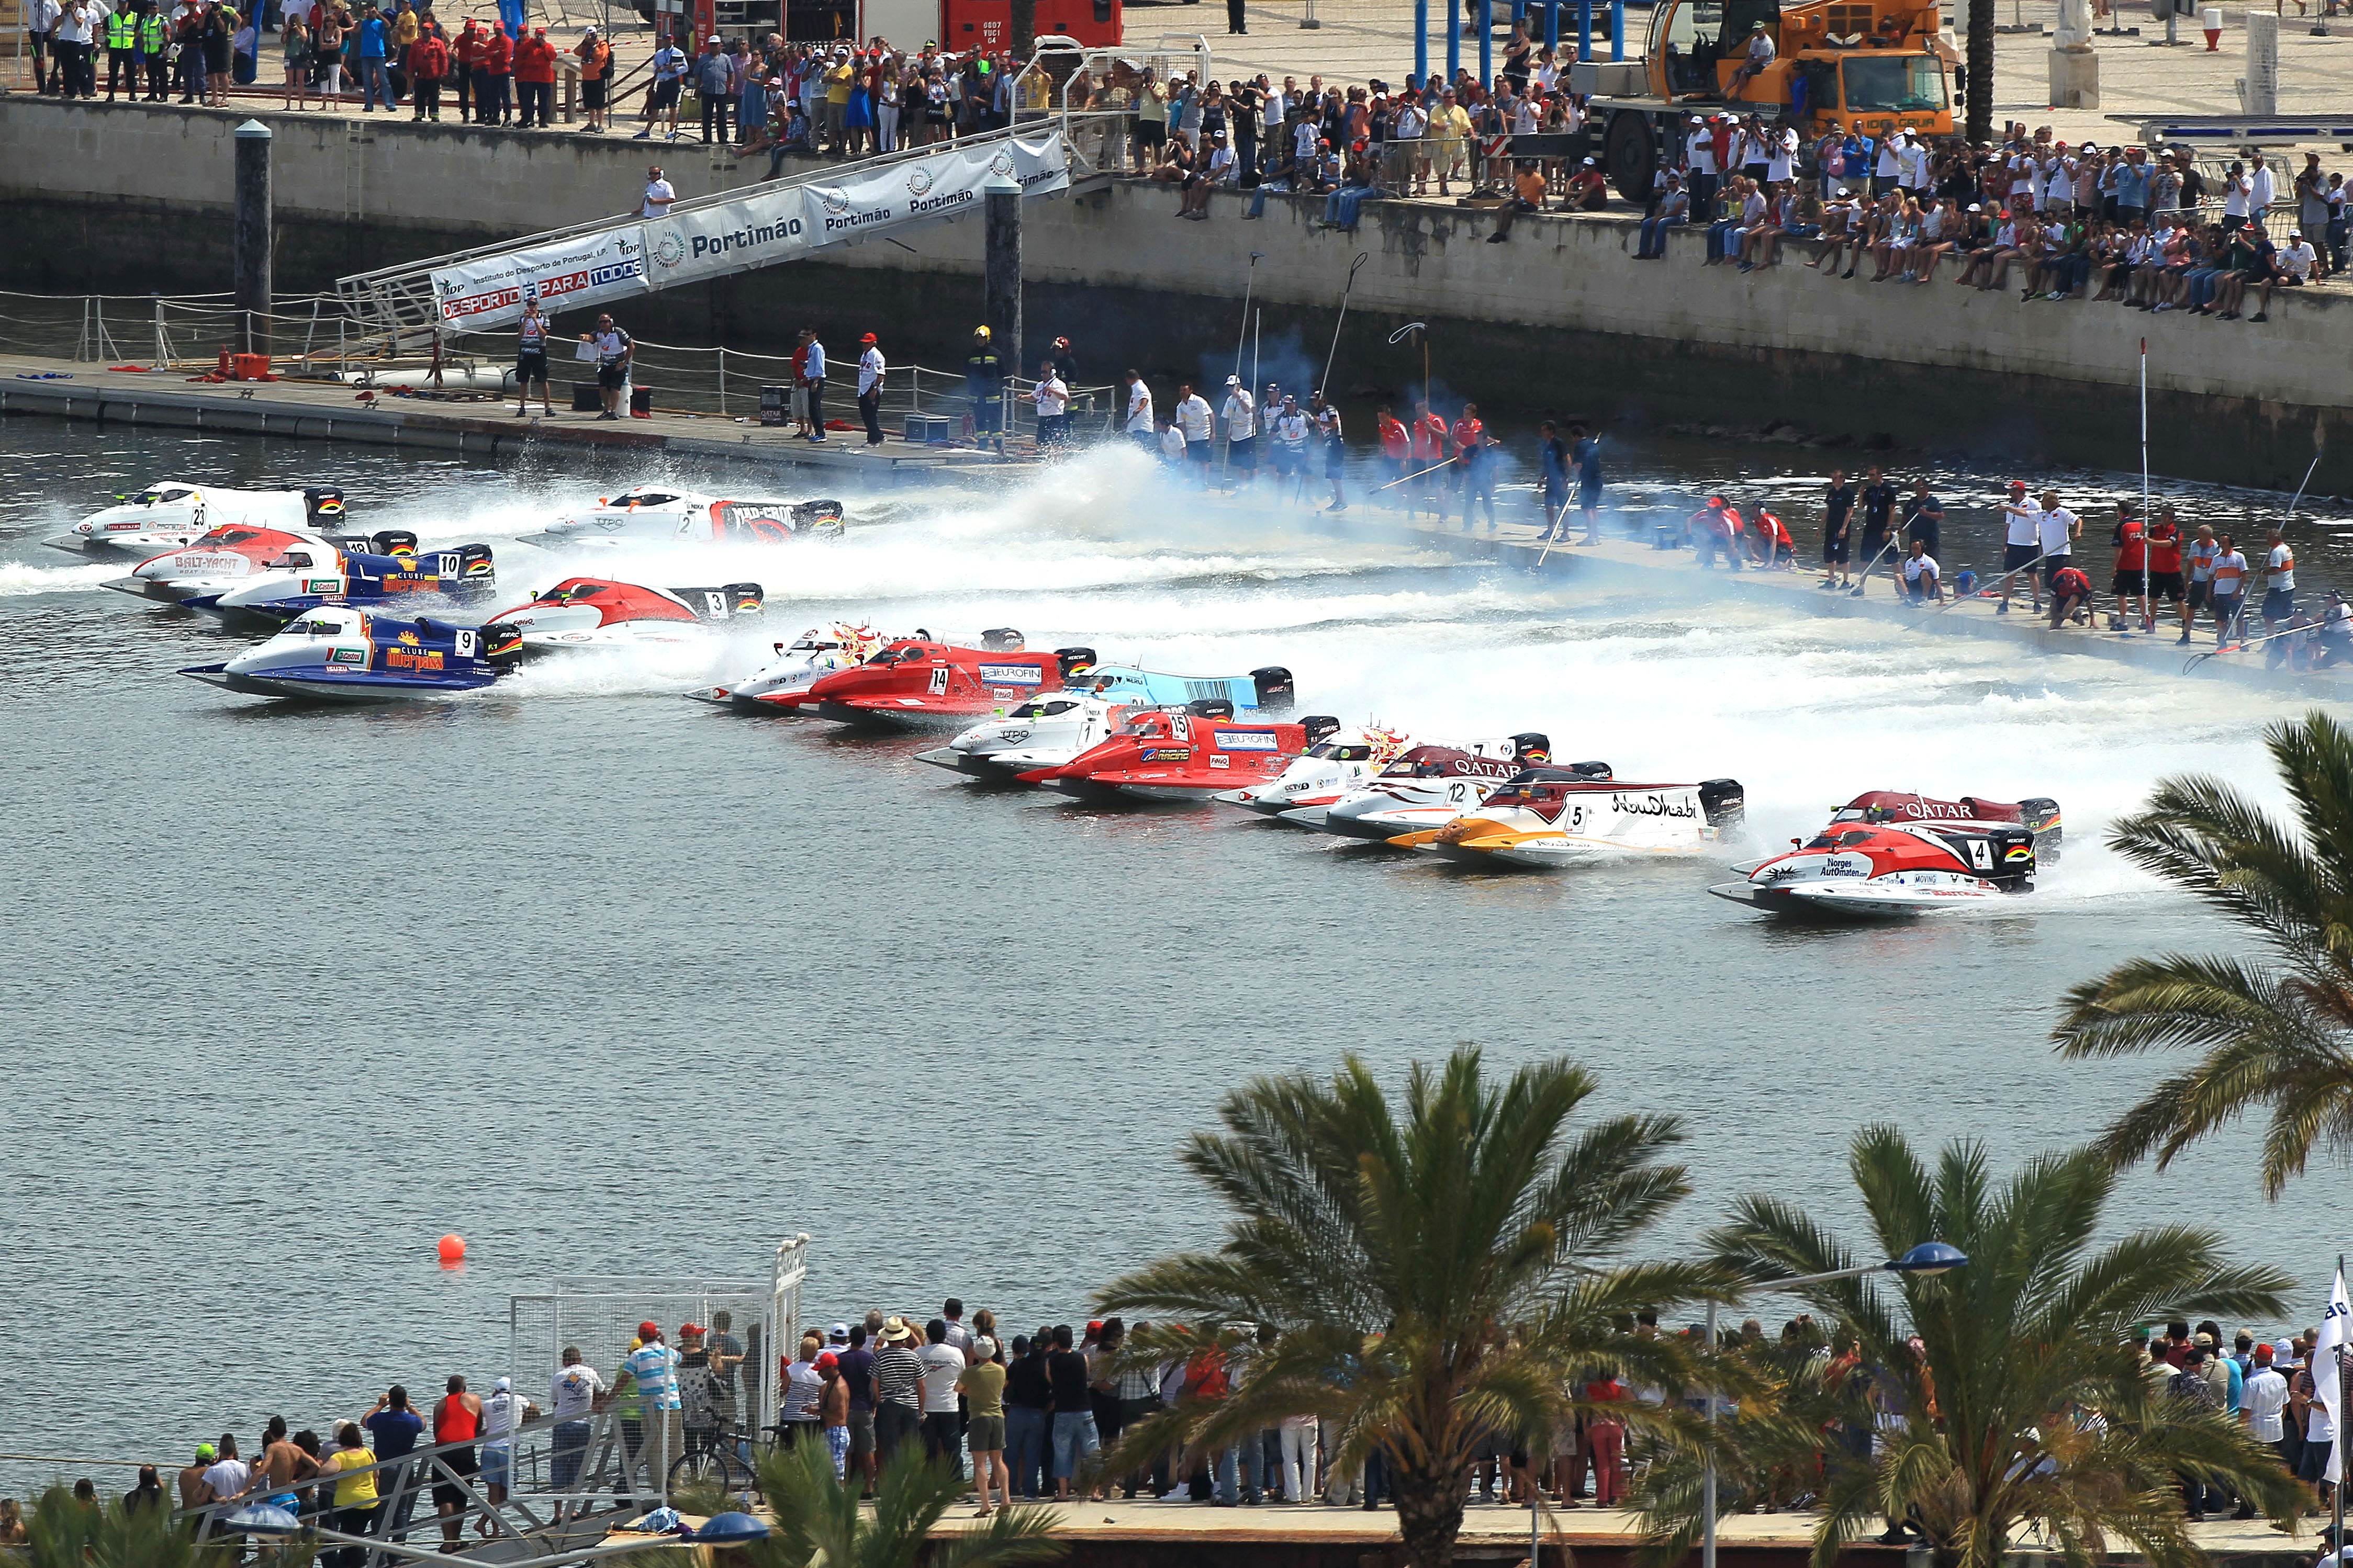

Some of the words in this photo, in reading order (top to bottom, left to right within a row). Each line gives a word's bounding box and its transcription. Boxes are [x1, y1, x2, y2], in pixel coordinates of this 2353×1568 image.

[1016, 170, 1054, 187] timão
[910, 189, 973, 212] Portimão
[826, 207, 890, 231] Portimão
[691, 216, 801, 258] Portimão
[622, 244, 640, 255] IDP
[473, 273, 503, 284] Instituto
[505, 269, 514, 278] do
[516, 262, 550, 274] Desporto
[552, 258, 562, 267] de
[563, 253, 596, 265] Portugal,
[443, 288, 521, 319] DESPORTO
[539, 274, 587, 298] PARA
[591, 262, 642, 285] TODOS
[445, 284, 465, 295] IDP
[194, 509, 204, 526] 23
[679, 516, 690, 533] 2
[351, 544, 366, 554] 18
[175, 557, 239, 569] BALT-YACHT
[442, 556, 457, 572] 10
[319, 582, 335, 590] Castrol
[712, 594, 722, 611] 3
[462, 632, 471, 649] 9
[343, 652, 360, 661] Castrol
[401, 647, 428, 656] CLUBE
[387, 648, 444, 673] interpass
[934, 670, 946, 687] 14
[996, 668, 1040, 679] EUROFIN
[1084, 724, 1090, 742] 1
[1171, 716, 1186, 734] 15
[1318, 725, 1338, 734] MERC
[1231, 733, 1275, 743] EUROFIN
[1474, 744, 1484, 757] 7
[1454, 759, 1521, 779] QATAR
[1449, 783, 1465, 802] 12
[1721, 796, 1742, 806] MERC
[1572, 806, 1582, 826] 5
[1906, 803, 1974, 819] QATAR
[2039, 807, 2058, 816] MERC
[1975, 842, 1985, 861] 4
[1828, 858, 1852, 869] Norges
